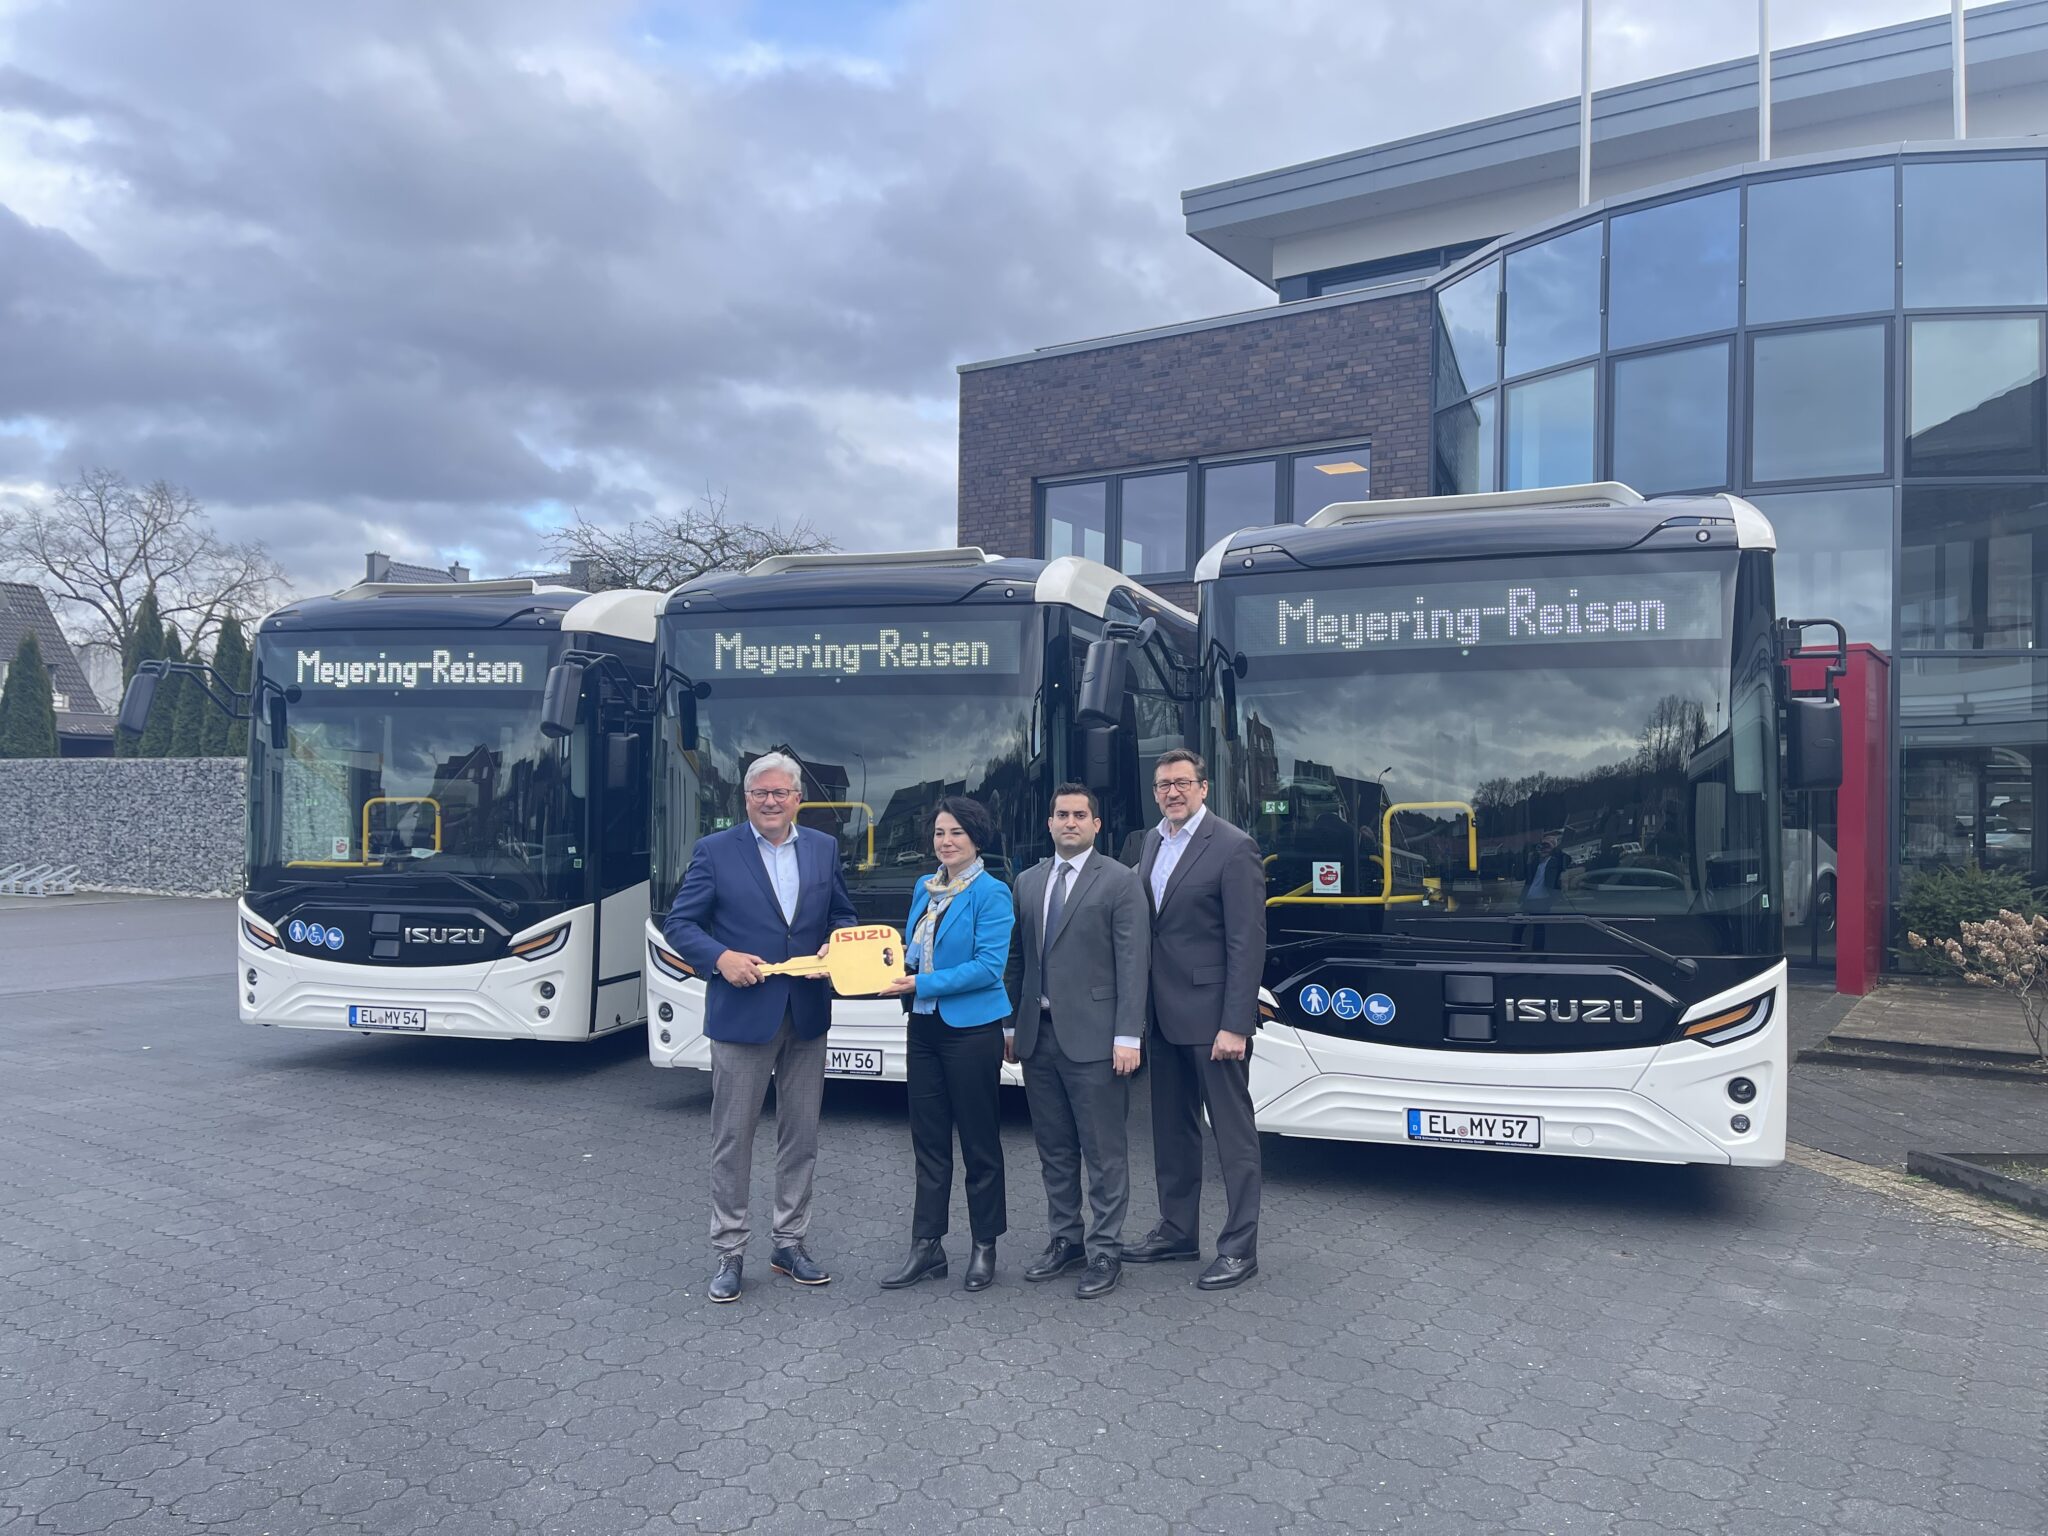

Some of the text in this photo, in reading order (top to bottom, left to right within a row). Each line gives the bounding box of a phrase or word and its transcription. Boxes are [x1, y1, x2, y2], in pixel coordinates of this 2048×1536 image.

[1278, 587, 1665, 649] Meyering-Reisen
[715, 629, 989, 674] Meyering-Reisen
[297, 650, 523, 688] Meyering-Reisen
[404, 927, 485, 944] ISUZU
[835, 928, 891, 943] ISUZU
[361, 1009, 377, 1023] EL
[385, 1011, 400, 1024] MY
[403, 1012, 419, 1025] 54
[1505, 998, 1643, 1023] ISUZU
[832, 1051, 874, 1069] MY 56
[1429, 1115, 1528, 1139] EL MY 57
